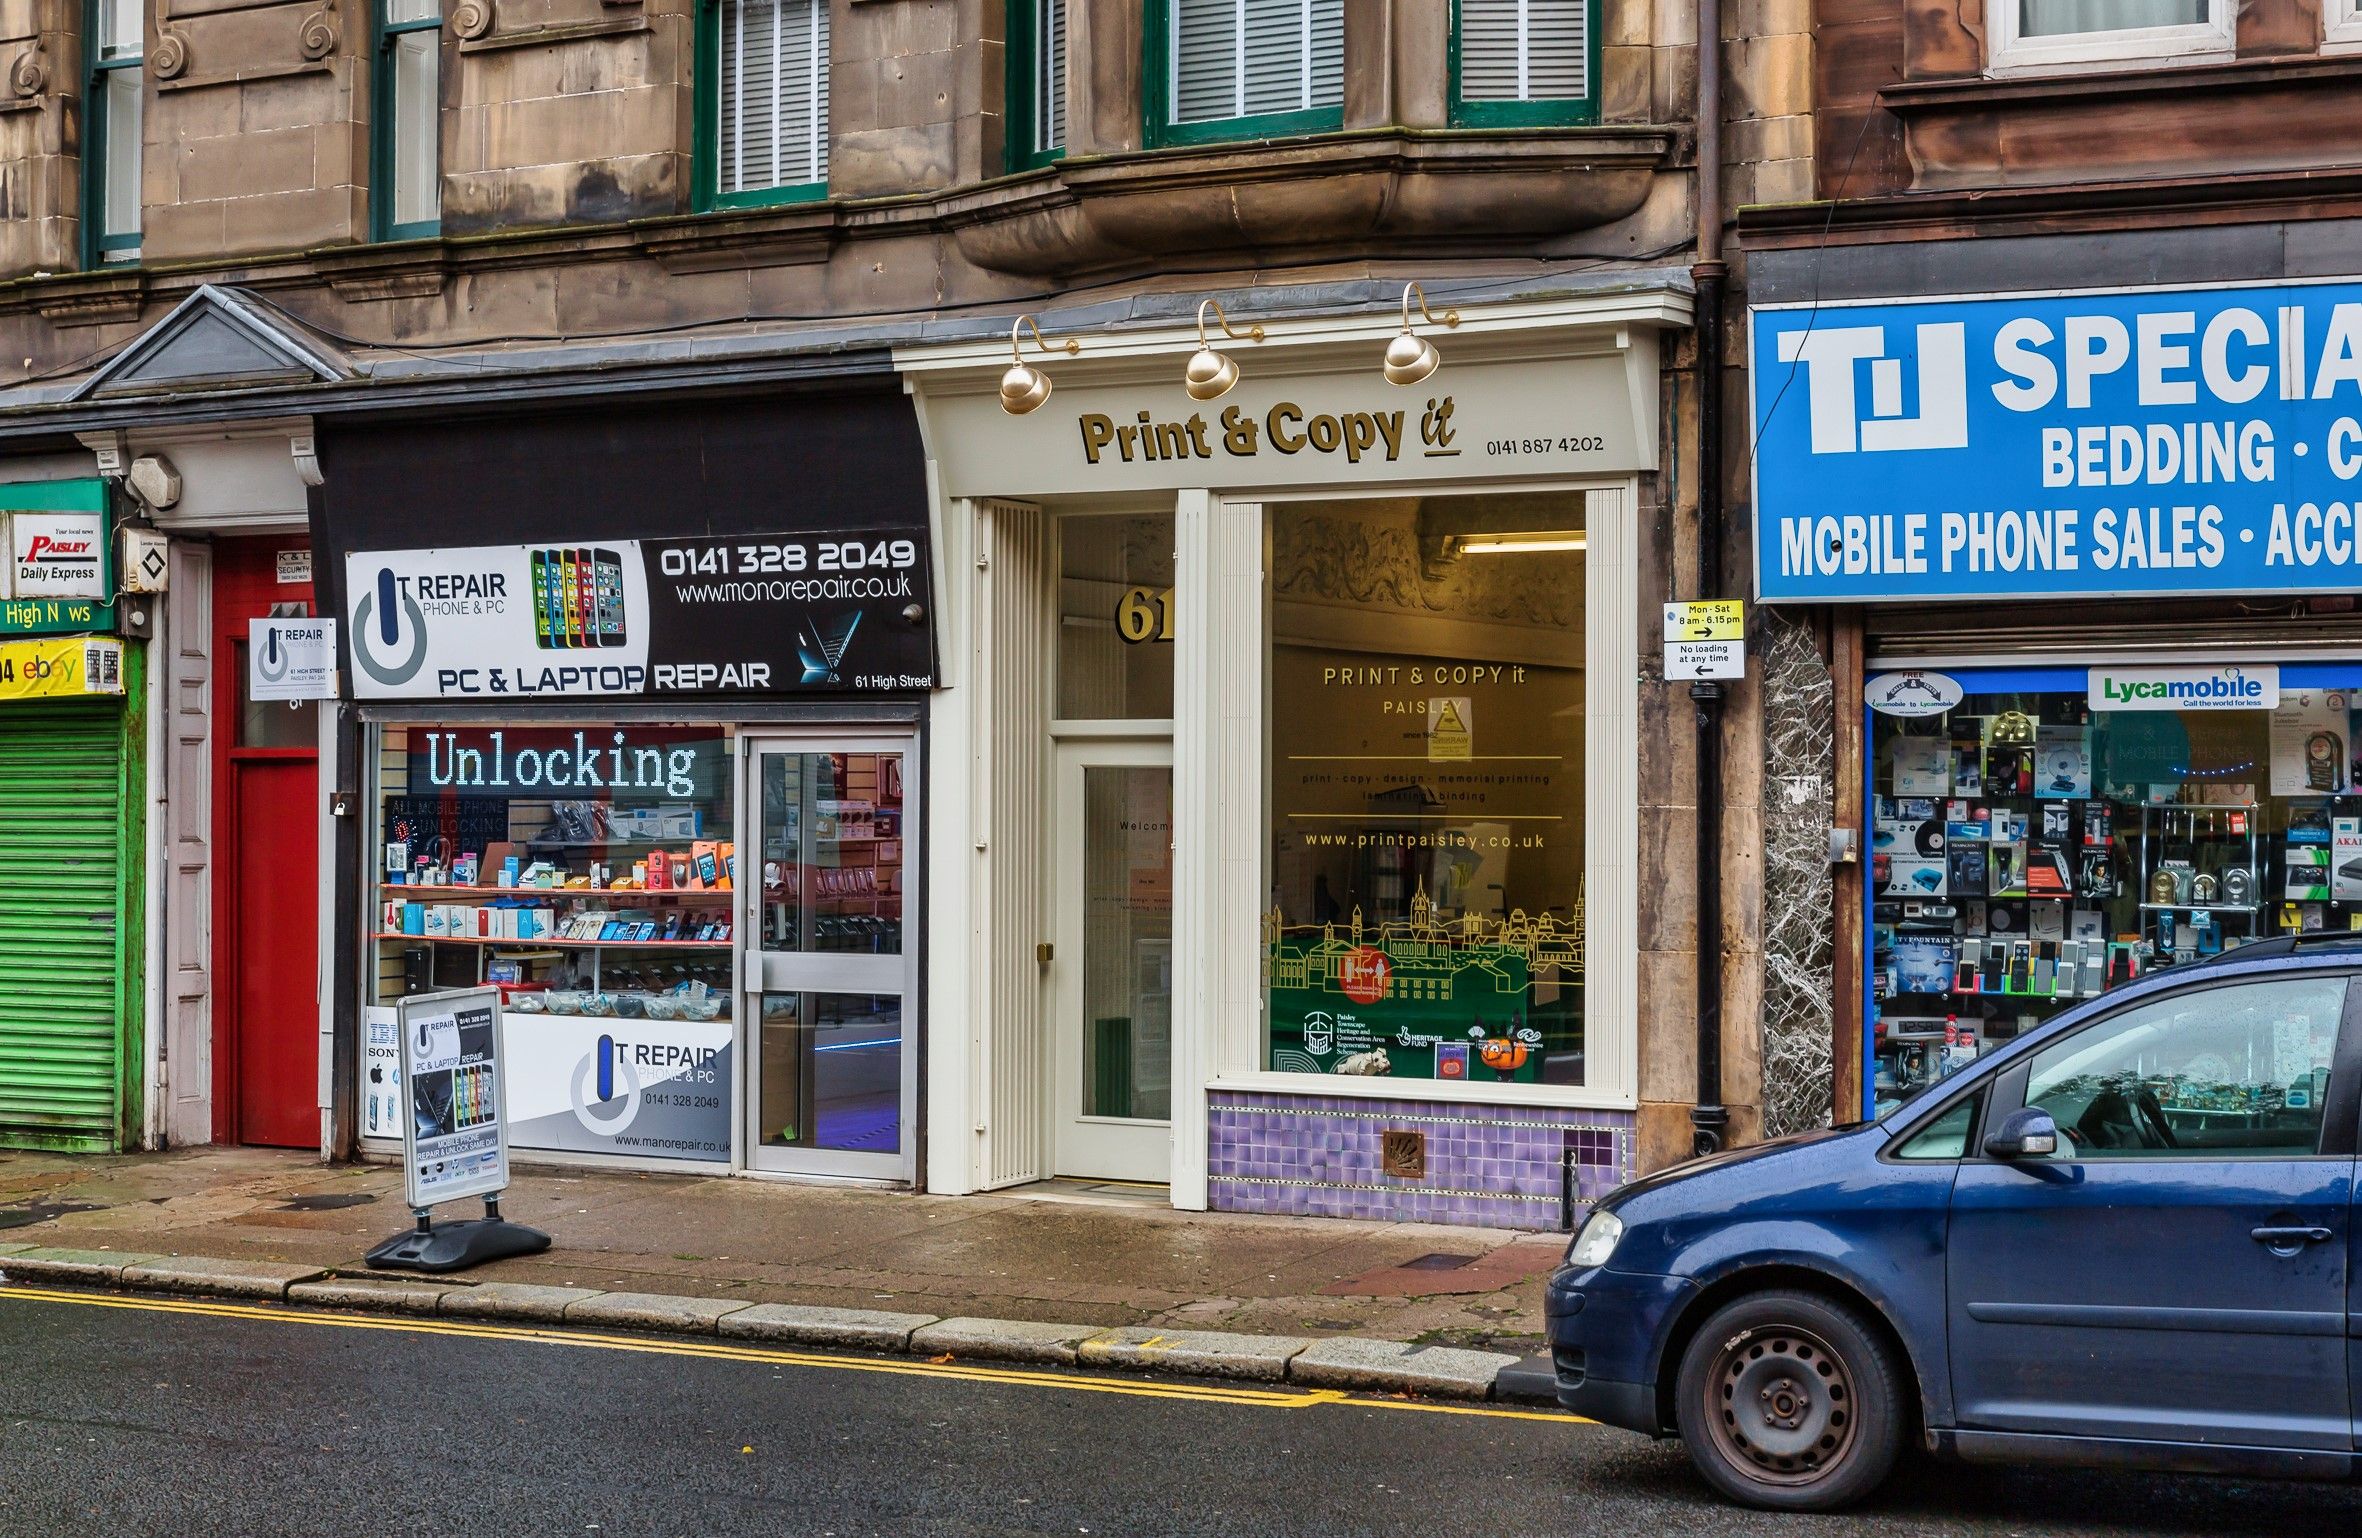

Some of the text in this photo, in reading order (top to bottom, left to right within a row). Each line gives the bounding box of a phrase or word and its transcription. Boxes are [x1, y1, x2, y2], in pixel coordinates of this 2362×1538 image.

[1079, 396, 1458, 464] Print & Copy it
[1487, 436, 1604, 456] 0141 887 4202
[2042, 419, 2275, 488] BEDDING
[1781, 502, 2362, 576] MOBILE PHONE SALES ACC
[24, 535, 91, 563] PAISLEY
[291, 552, 298, 560] &
[661, 540, 916, 577] 0141 328 2049
[21, 567, 95, 581] Daily Express
[278, 566, 310, 574] SECURITY
[418, 572, 506, 600] REPAIR
[676, 572, 911, 603] www.monorepair.co.uk
[6, 602, 42, 629] High
[423, 599, 505, 615] PHONE & PC
[1715, 605, 1730, 613] Sat
[1706, 616, 1725, 624] 6.15
[1727, 617, 1740, 625] pm
[286, 629, 323, 640] REPAIR
[1696, 645, 1728, 653] loading
[1710, 654, 1729, 662] time
[24, 655, 76, 682] ebay
[439, 662, 771, 693] PC & LAPTOP REPAIR
[1324, 665, 1526, 685] PRINT & COPY it
[855, 673, 932, 690] 61 High Street
[2104, 674, 2262, 703] Lycamobile
[1384, 700, 1463, 714] PAISLEY
[1872, 699, 1906, 708] Lycamobile
[426, 731, 696, 797] Unlocking
[1305, 832, 1545, 850] www.printpaisley.co.uk
[431, 1020, 454, 1031] REPAIR
[368, 1048, 399, 1058] SON
[416, 1052, 484, 1071] PC & LAPTOP REPAIR
[635, 1044, 718, 1069] REPAIR
[639, 1067, 715, 1084] PHONE & PC
[646, 1093, 719, 1109] 0141 328 2049
[417, 1150, 440, 1160] REPAIR
[445, 1143, 469, 1155] UNLOCK
[469, 1140, 486, 1150] SAME
[485, 1137, 497, 1146] DAY
[438, 1133, 480, 1148] MOBILE PHONE
